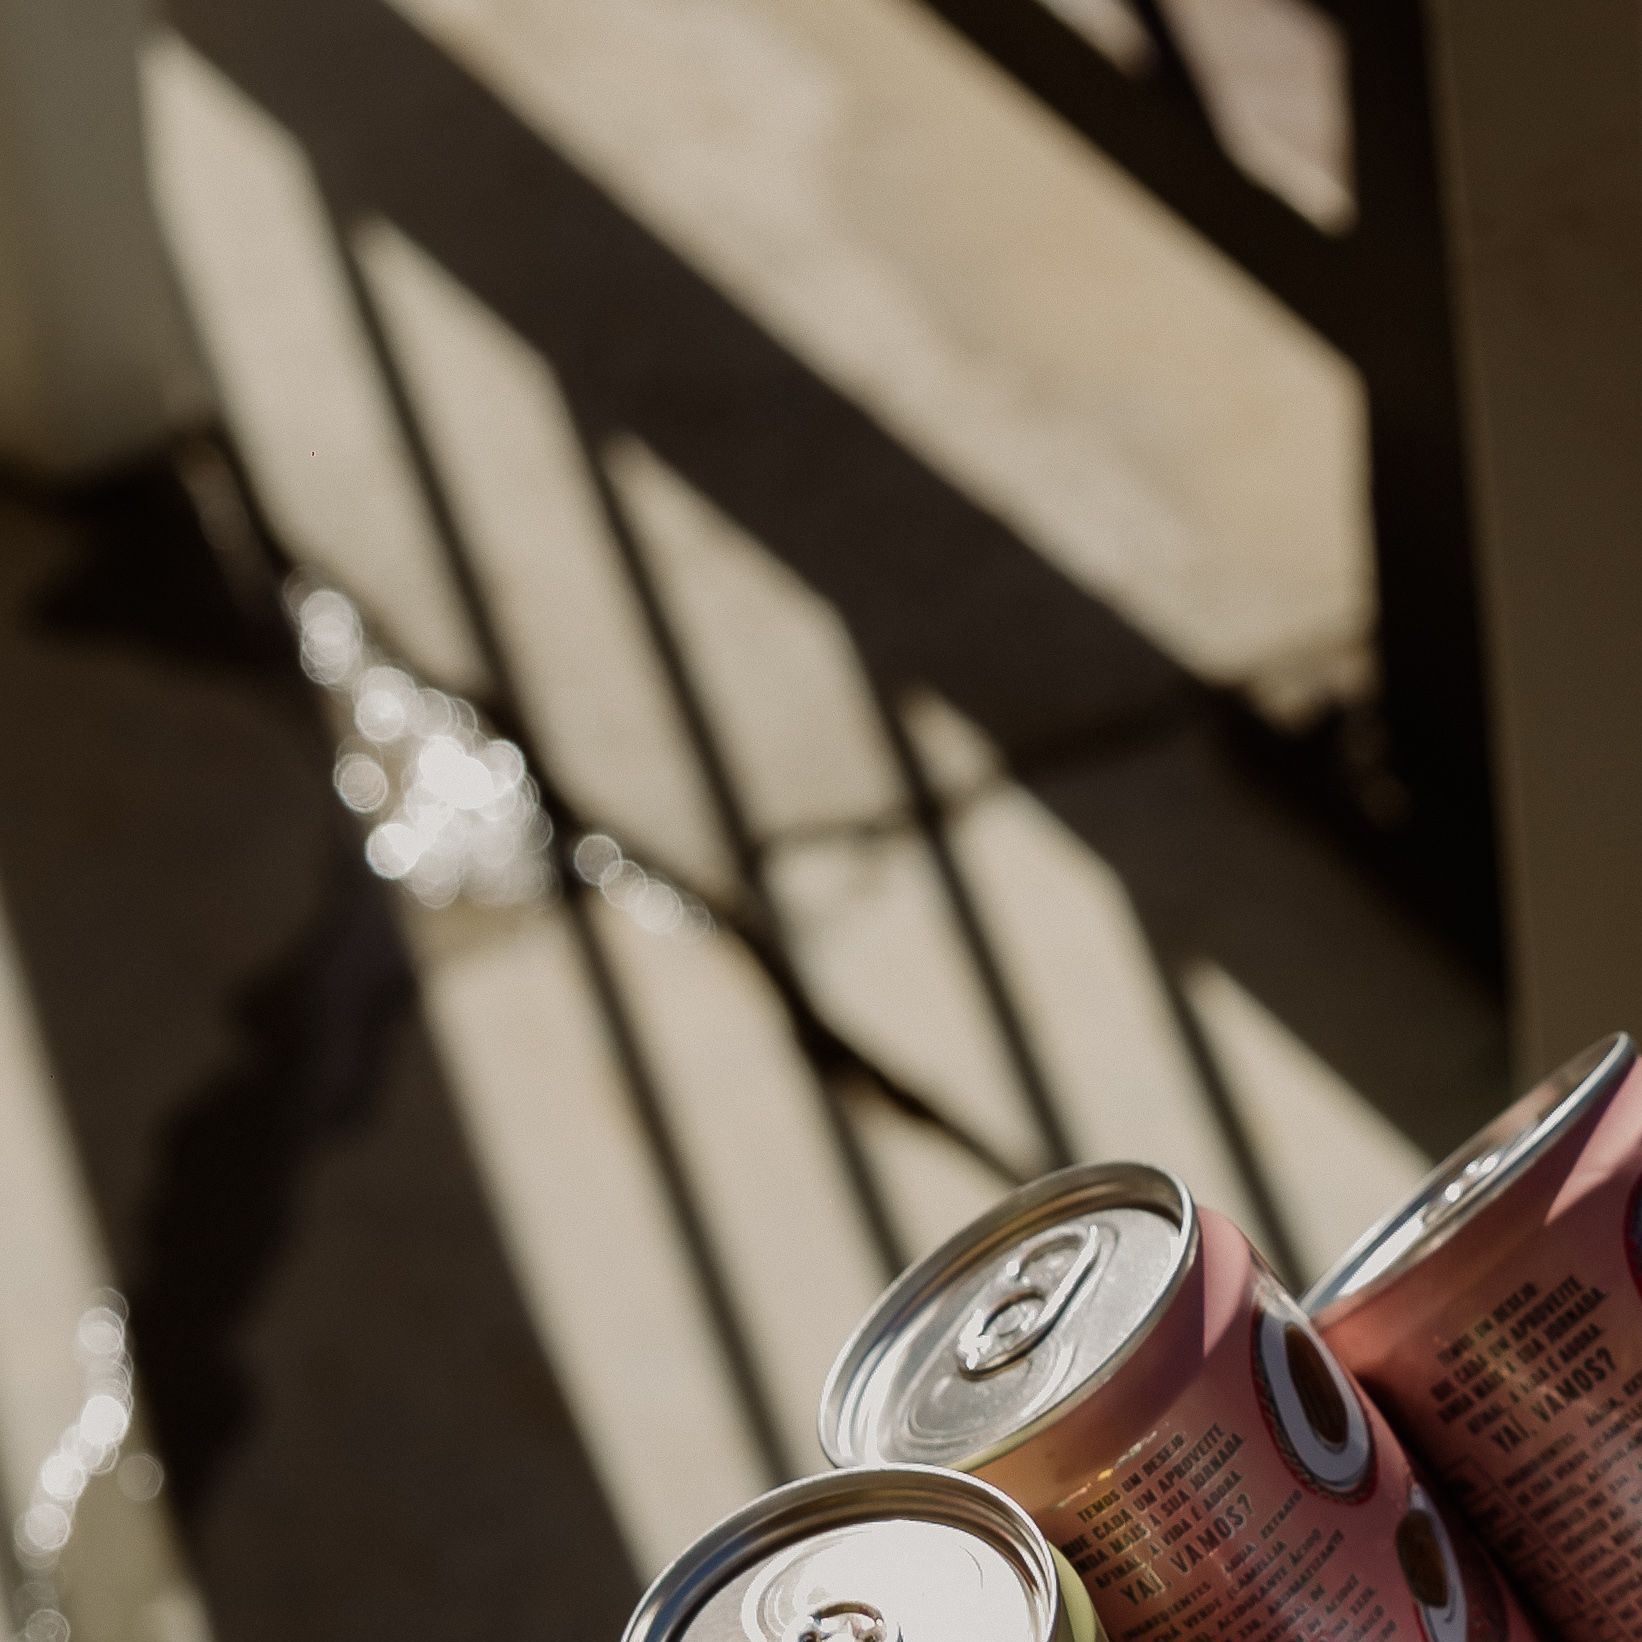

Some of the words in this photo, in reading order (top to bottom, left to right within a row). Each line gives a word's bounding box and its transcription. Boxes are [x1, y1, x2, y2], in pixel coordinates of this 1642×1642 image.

[1531, 1347, 1615, 1422] VAMOS?
[1076, 1489, 1120, 1522] TEMOS
[1092, 1508, 1132, 1540] CADA
[1132, 1488, 1156, 1510] UM
[1160, 1489, 1190, 1517] SUA
[1170, 1494, 1251, 1571] VAMOS?
